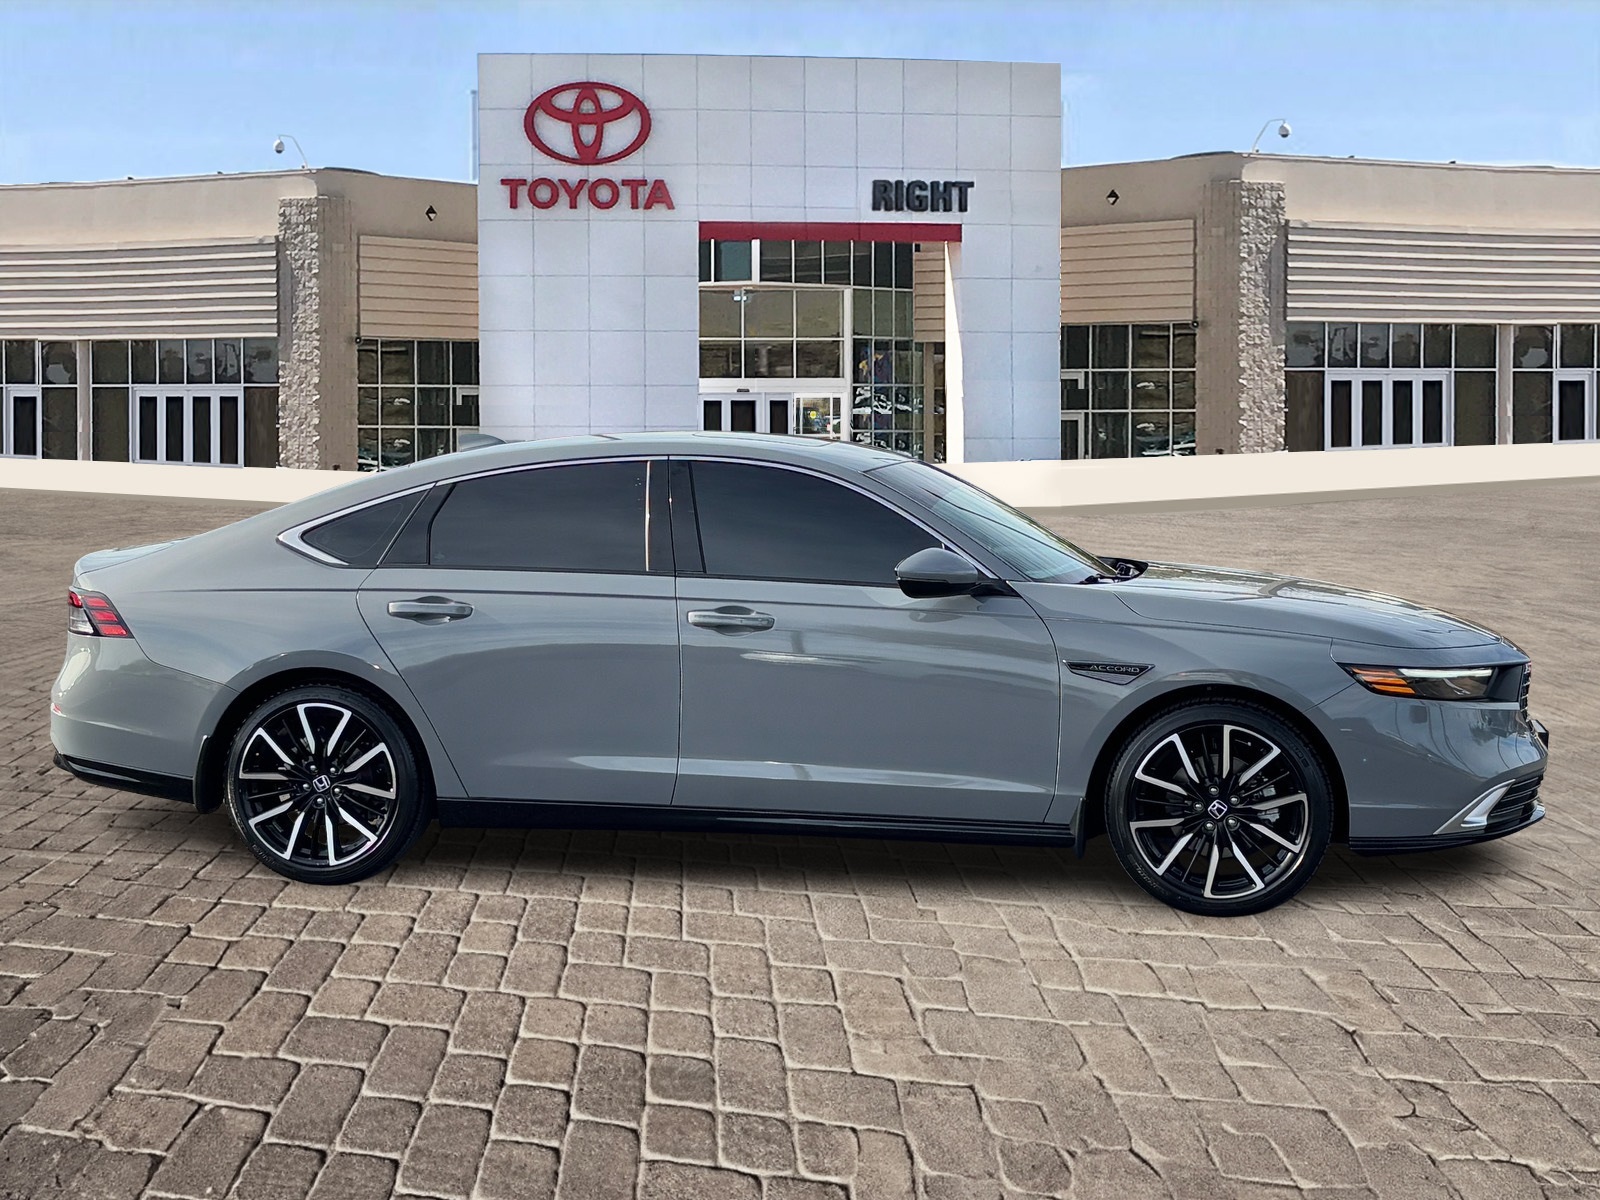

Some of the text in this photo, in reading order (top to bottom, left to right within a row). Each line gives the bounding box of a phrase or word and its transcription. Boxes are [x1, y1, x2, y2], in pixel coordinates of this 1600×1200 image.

[500, 178, 675, 210] TOYOTA
[872, 180, 975, 212] RIGHT
[1089, 664, 1140, 673] ACCORD
